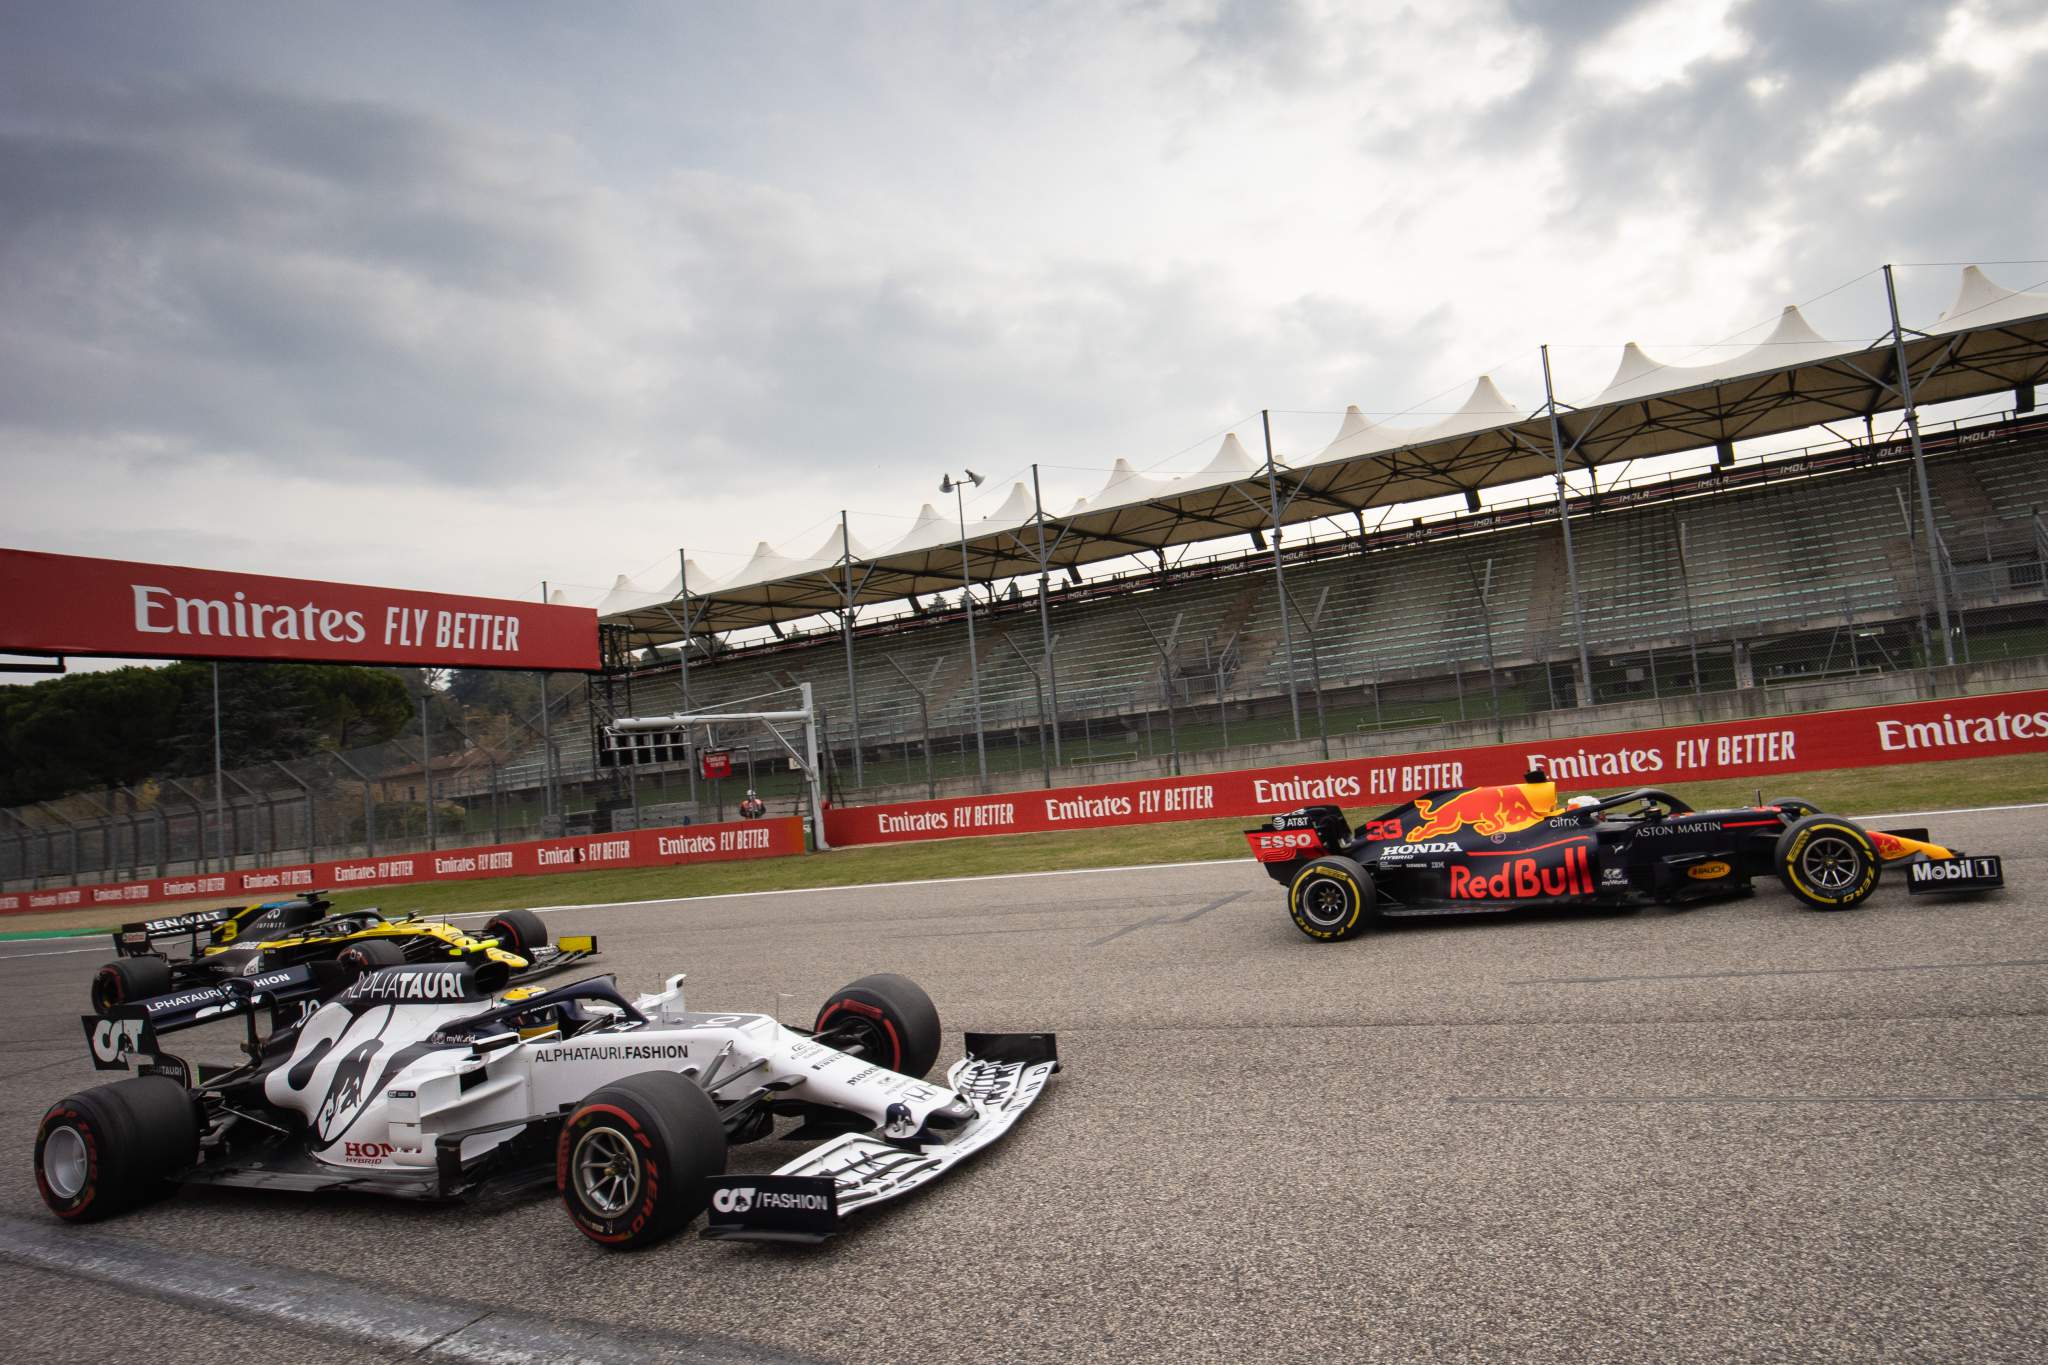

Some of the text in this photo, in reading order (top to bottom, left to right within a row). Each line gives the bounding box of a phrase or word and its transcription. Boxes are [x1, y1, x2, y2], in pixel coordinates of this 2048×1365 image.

[1959, 429, 1996, 443] IMOLA
[1780, 461, 1814, 474] IMOLA
[1697, 476, 1729, 489] IMOLA
[1619, 491, 1650, 503] IMOLA
[1544, 504, 1574, 515] IMA
[131, 584, 520, 652] Emirates FLY BETTER
[1876, 711, 2048, 751] Emirates
[1526, 730, 1796, 780] Emirates FLY BETTER
[1253, 762, 1464, 804] Emirates FLY BETTER
[1046, 785, 1214, 822] Emirates FLY BETTER
[878, 803, 1014, 834] Emirates FLY BETTER
[1286, 816, 1309, 828] AT&T
[1550, 815, 1580, 829] citrix
[1366, 818, 1403, 841] 33
[1635, 821, 1722, 838] ASTON MARTIN
[659, 828, 770, 856] Emirates FLY BETTER
[1260, 833, 1311, 849] ESSO
[1381, 841, 1463, 857] HONDA
[538, 840, 631, 866] Emirats FLY BETTER
[335, 865, 376, 882] Emirates
[435, 856, 476, 874] Emirates
[1912, 859, 1973, 882] Mobil
[146, 988, 222, 1012] LPHATAURI
[535, 1045, 689, 1063] ALPHATAURI.FASHION
[345, 1142, 422, 1157] HON
[346, 1157, 383, 1166] HYBRID
